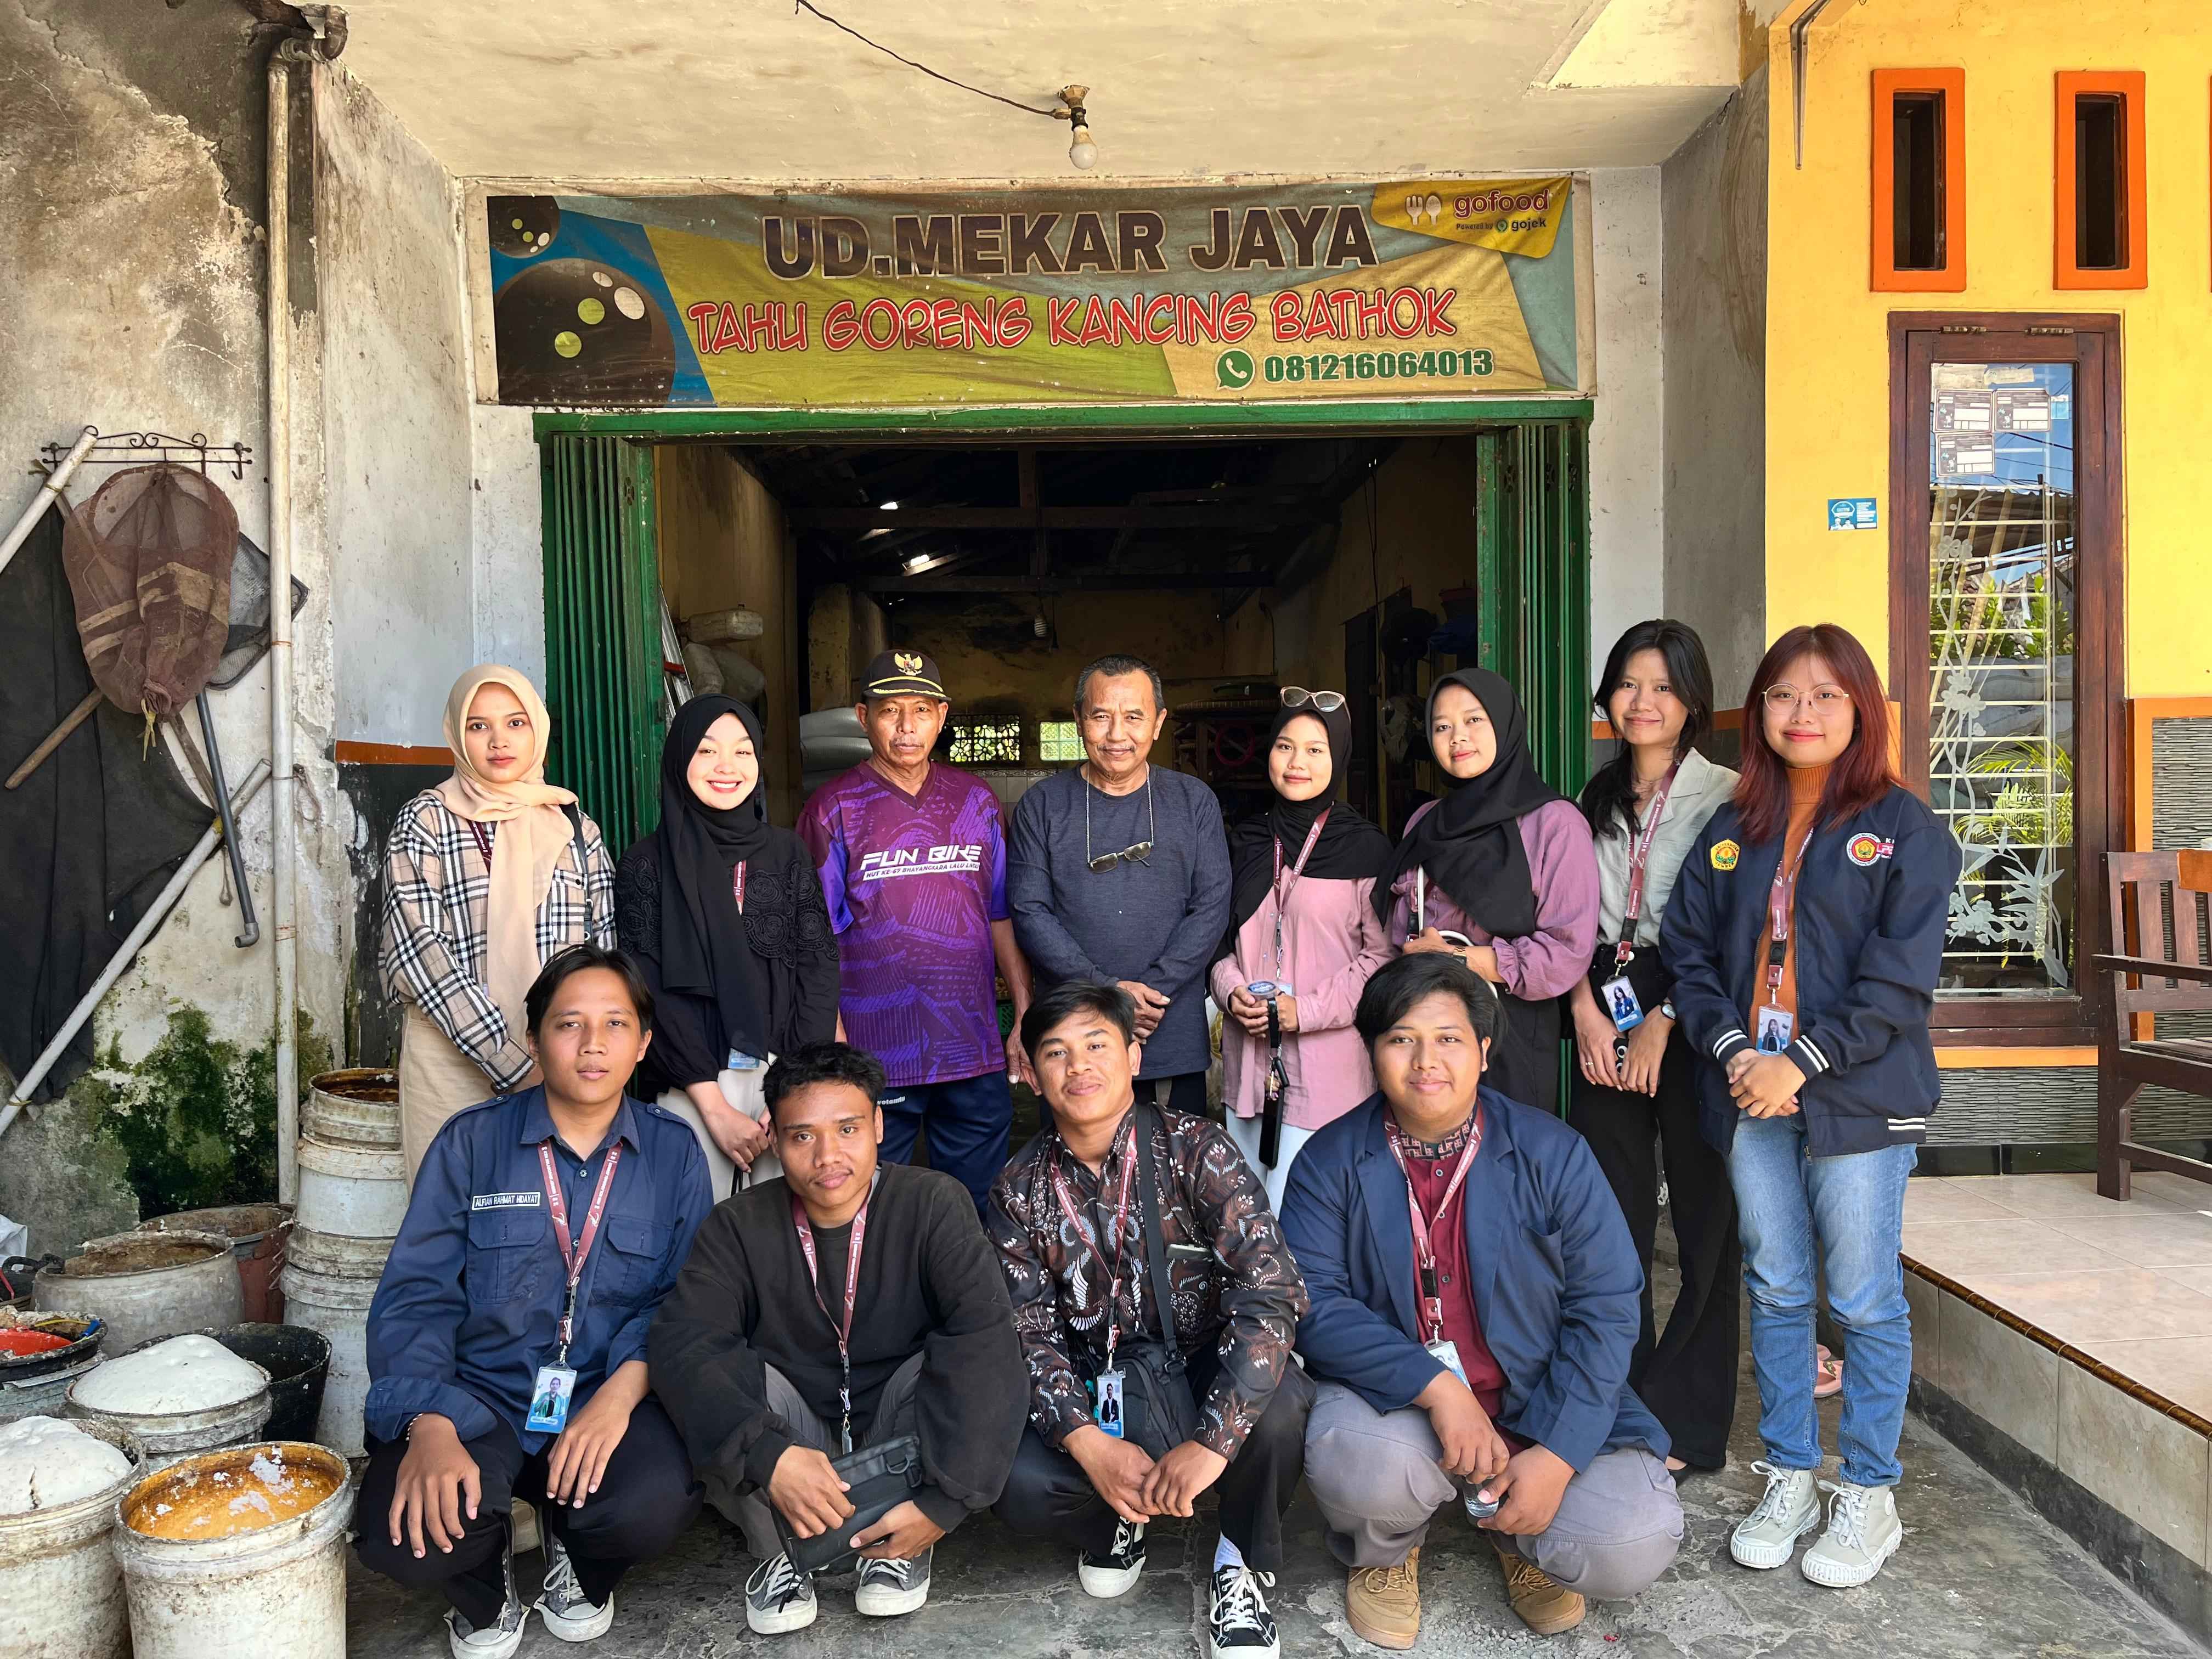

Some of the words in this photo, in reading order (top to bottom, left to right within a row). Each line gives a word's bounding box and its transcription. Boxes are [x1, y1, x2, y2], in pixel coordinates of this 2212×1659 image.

[1454, 189, 1550, 219] gofood
[1485, 222, 1493, 230] by
[1511, 218, 1547, 232] gojek
[763, 211, 1168, 280] UD.MEKAR
[1188, 205, 1379, 271] JAYA
[688, 301, 808, 355] TAHU
[821, 296, 1034, 353] GORENG
[1049, 291, 1257, 348] KANCING
[1271, 287, 1457, 345] BATHOK
[1264, 349, 1494, 382] 081216064013
[860, 848, 919, 871] FUN
[928, 845, 982, 862] BIKE
[476, 1198, 493, 1207] ALFIAN
[493, 1195, 515, 1204] RAHMAT
